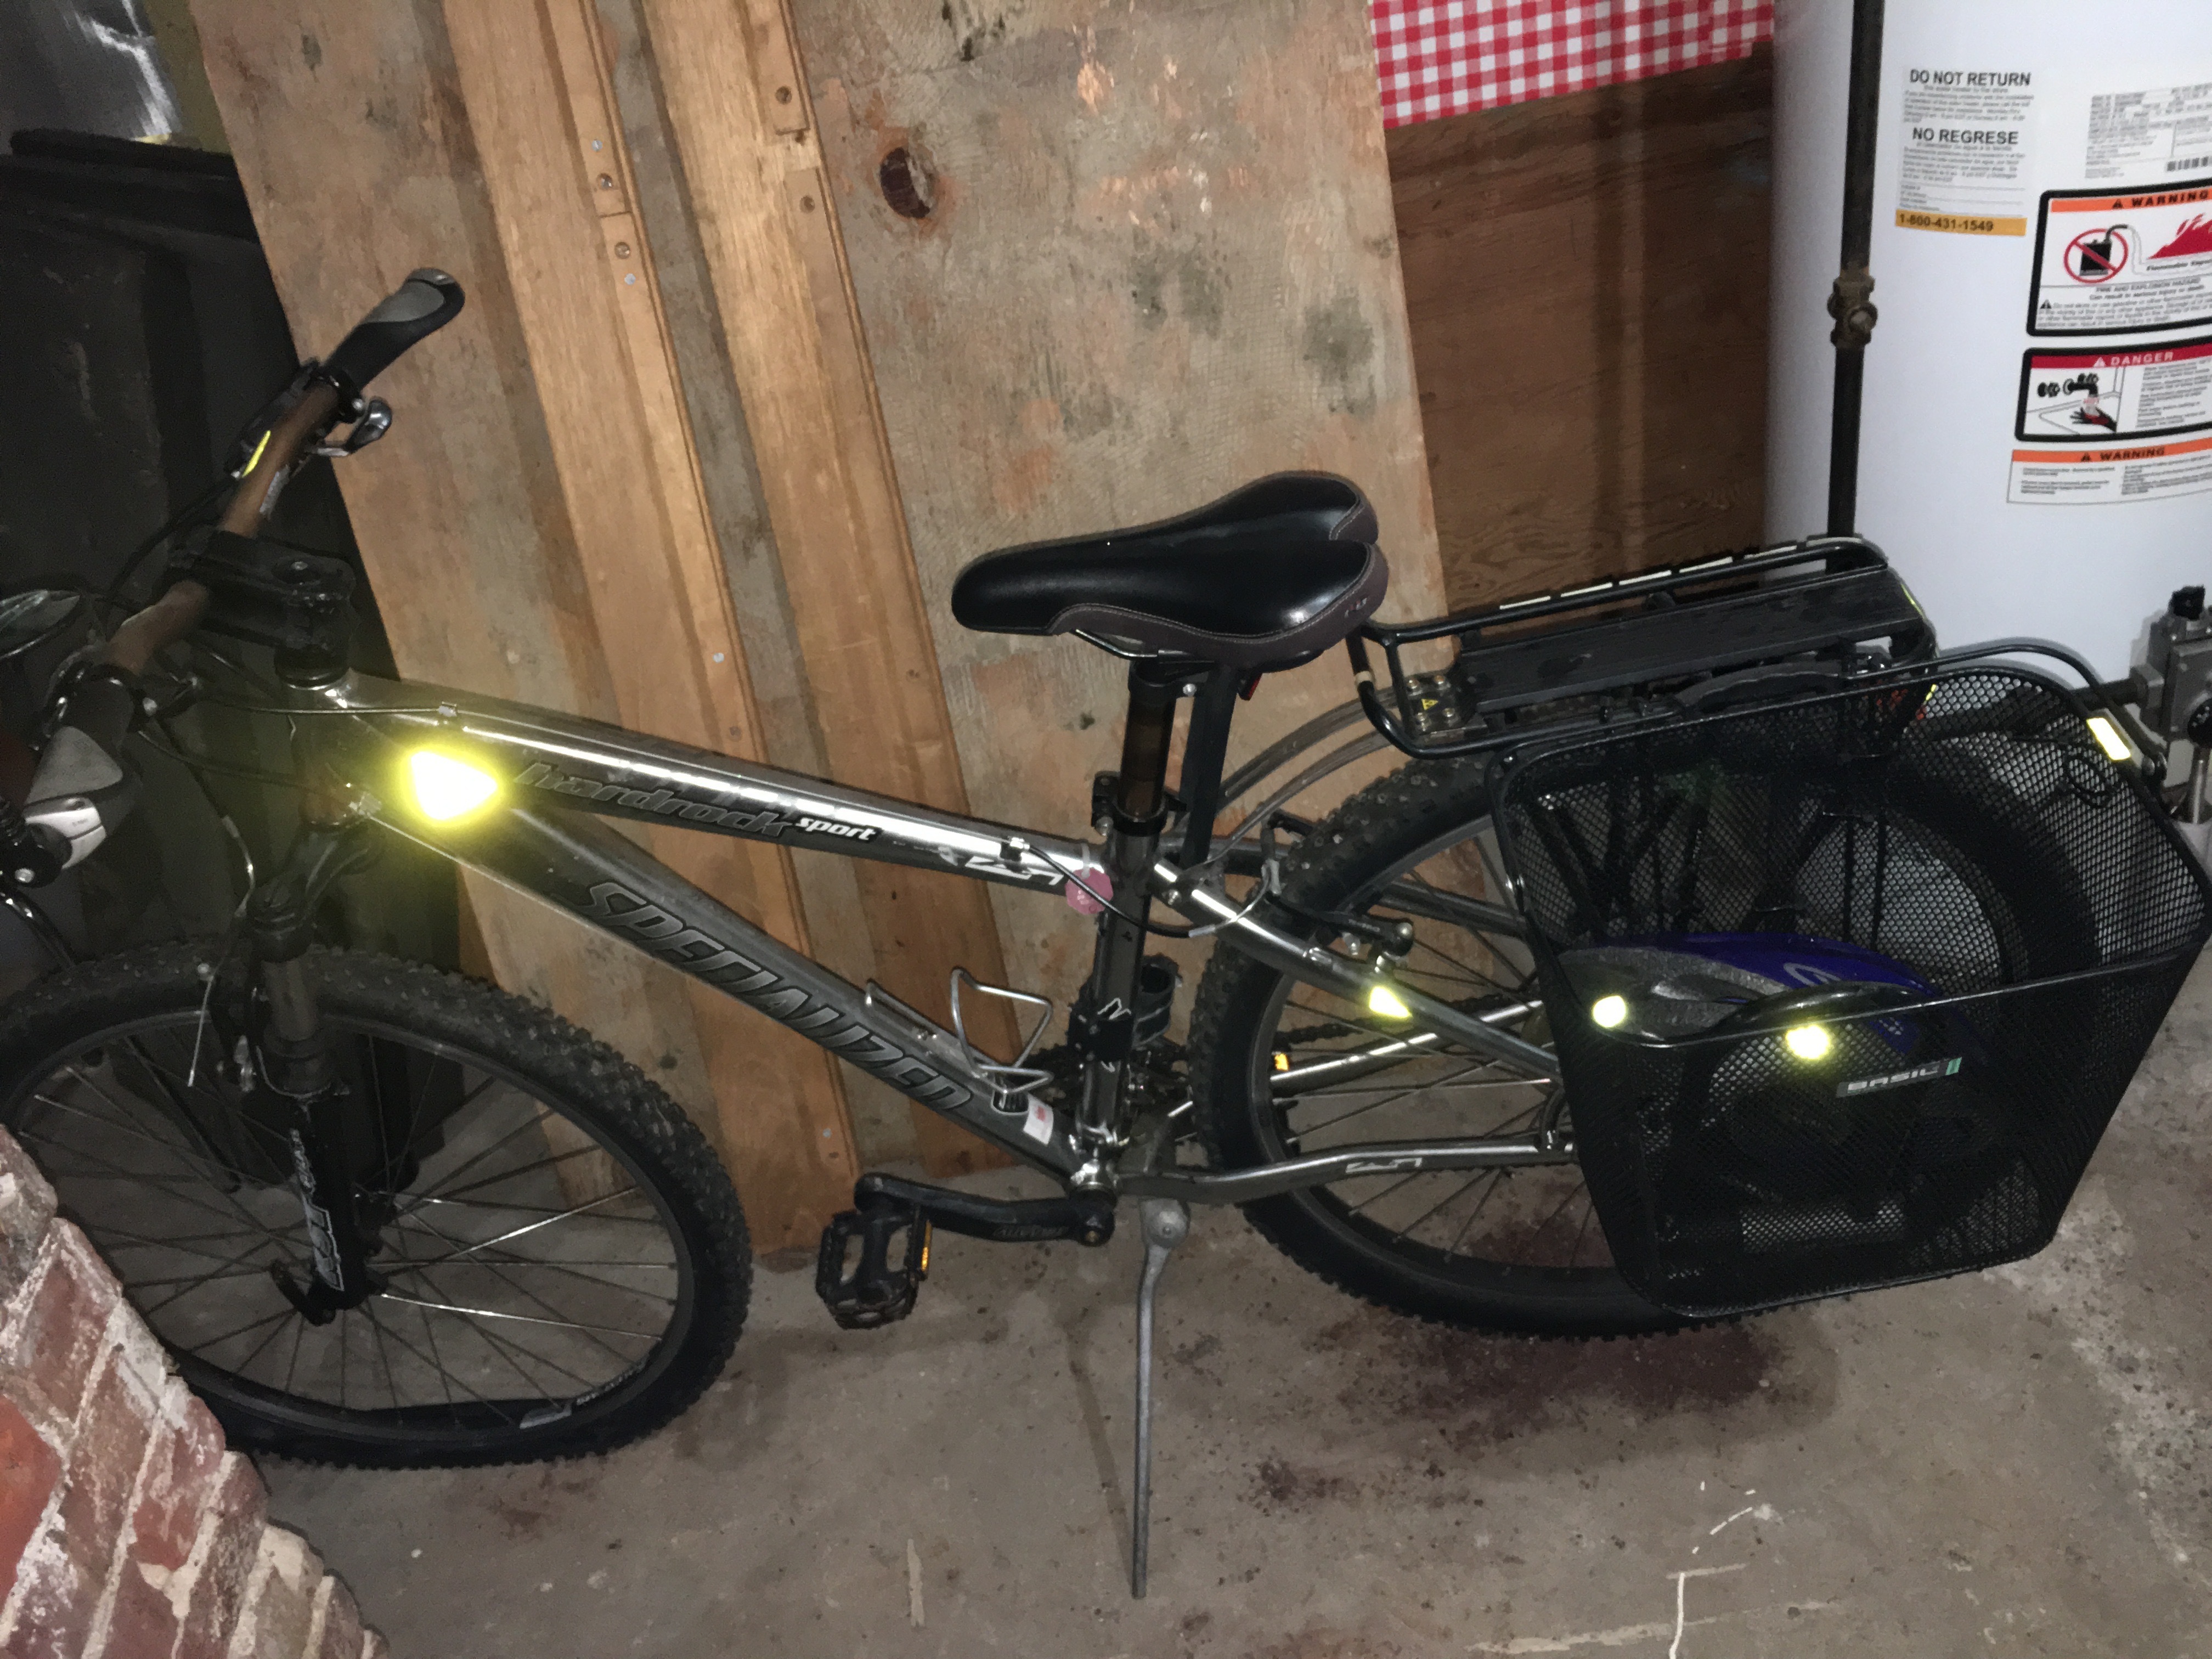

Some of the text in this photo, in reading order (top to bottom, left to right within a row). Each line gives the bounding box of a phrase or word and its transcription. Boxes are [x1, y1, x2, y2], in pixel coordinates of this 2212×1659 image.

[1909, 69, 2032, 87] DO NOT RETURN
[1912, 127, 2019, 145] NO REGRESE
[2131, 189, 2209, 207] WARNING
[2110, 352, 2174, 366] DANGER
[2100, 447, 2165, 461] WARNING
[795, 815, 878, 841] sport
